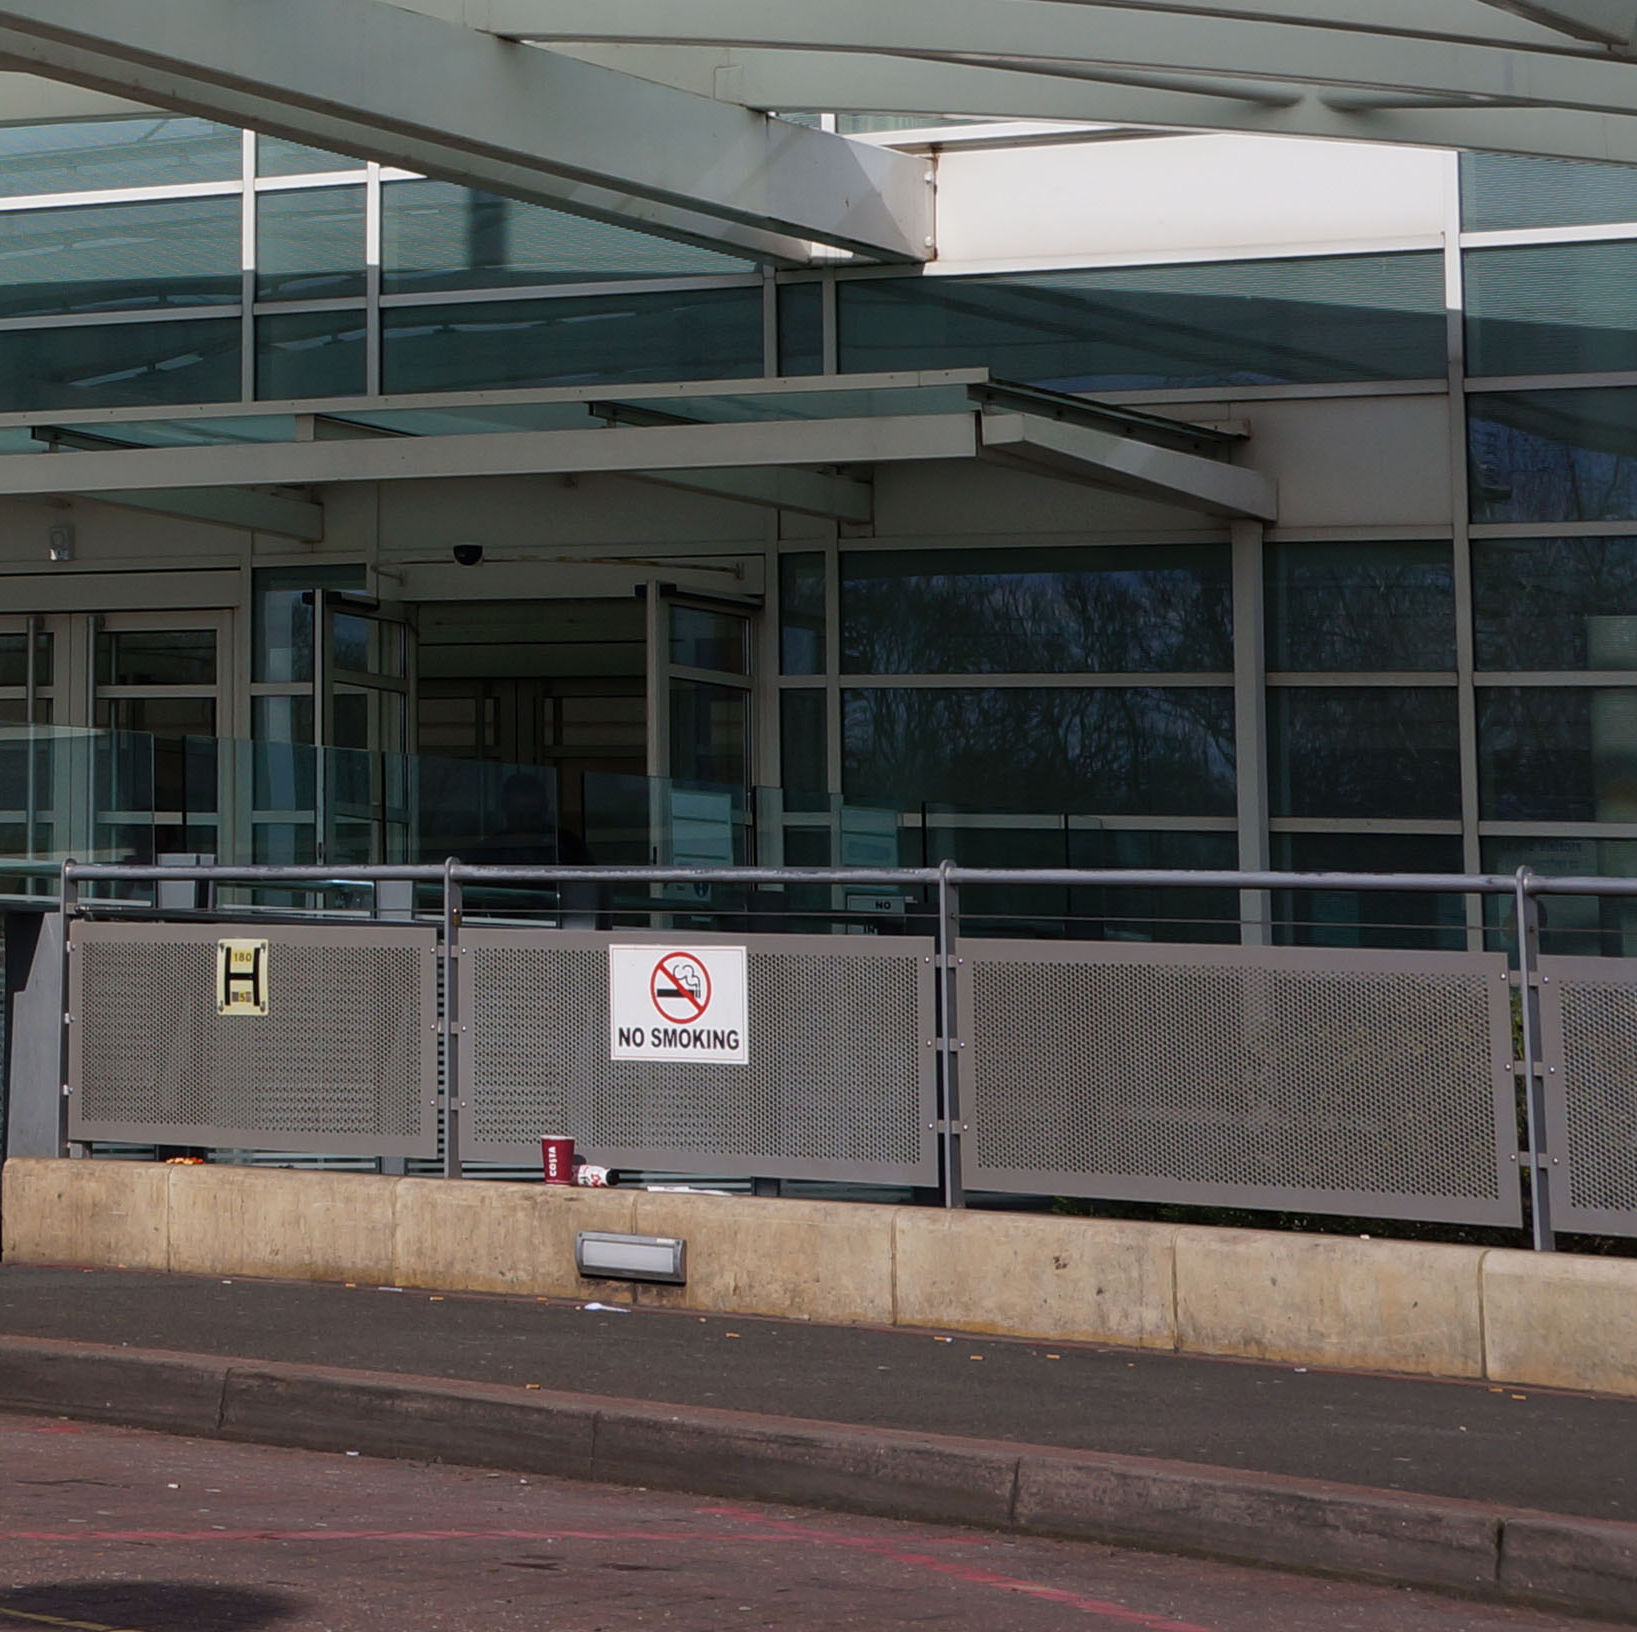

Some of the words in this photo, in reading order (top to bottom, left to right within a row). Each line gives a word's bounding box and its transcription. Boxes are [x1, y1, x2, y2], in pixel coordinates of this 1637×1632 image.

[875, 900, 892, 910] NO
[233, 951, 253, 962] 180
[224, 946, 261, 1006] H
[618, 1026, 645, 1048] NO
[650, 1027, 740, 1051] SMOKING
[548, 1146, 558, 1177] COSTA
